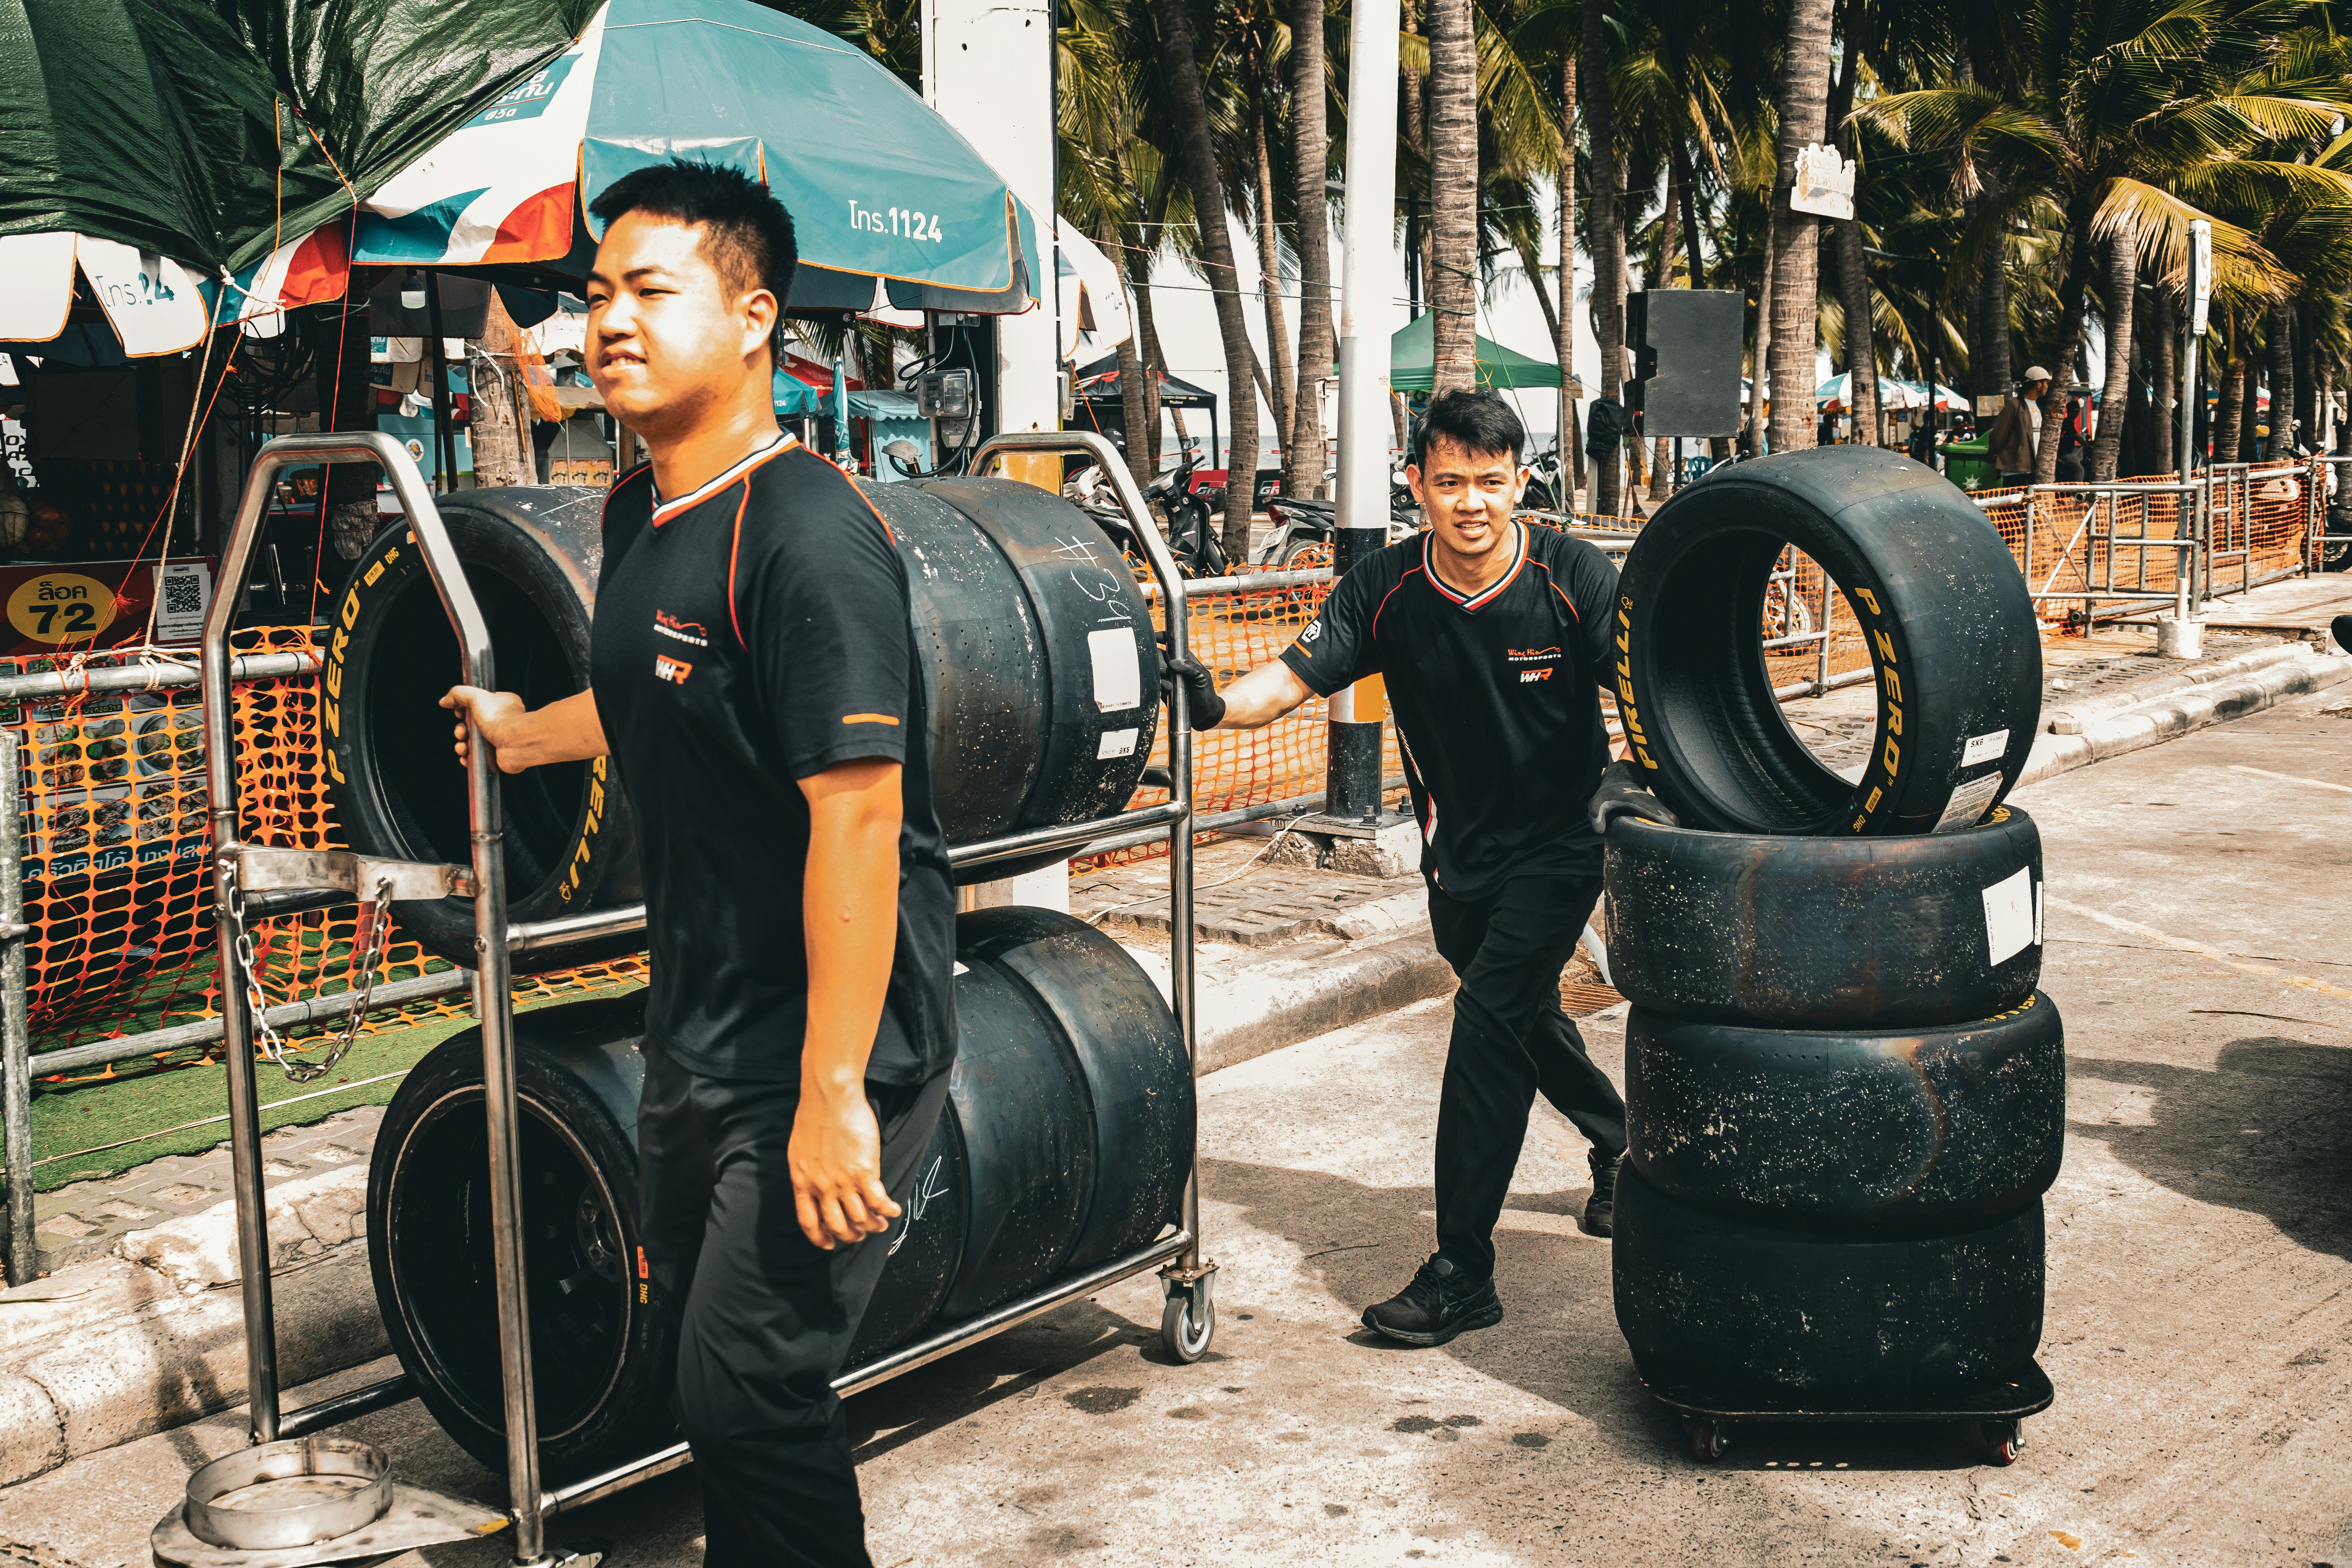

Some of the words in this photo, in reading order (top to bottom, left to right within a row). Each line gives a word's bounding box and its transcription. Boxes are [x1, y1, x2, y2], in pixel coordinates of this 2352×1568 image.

[848, 199, 942, 243] โทร.1124
[38, 581, 87, 601] ล็อค
[1855, 588, 1881, 615] P
[29, 602, 97, 634] 72
[1617, 610, 1658, 769] PIRELLI
[328, 749, 345, 784] P
[1853, 814, 1866, 832] DHG
